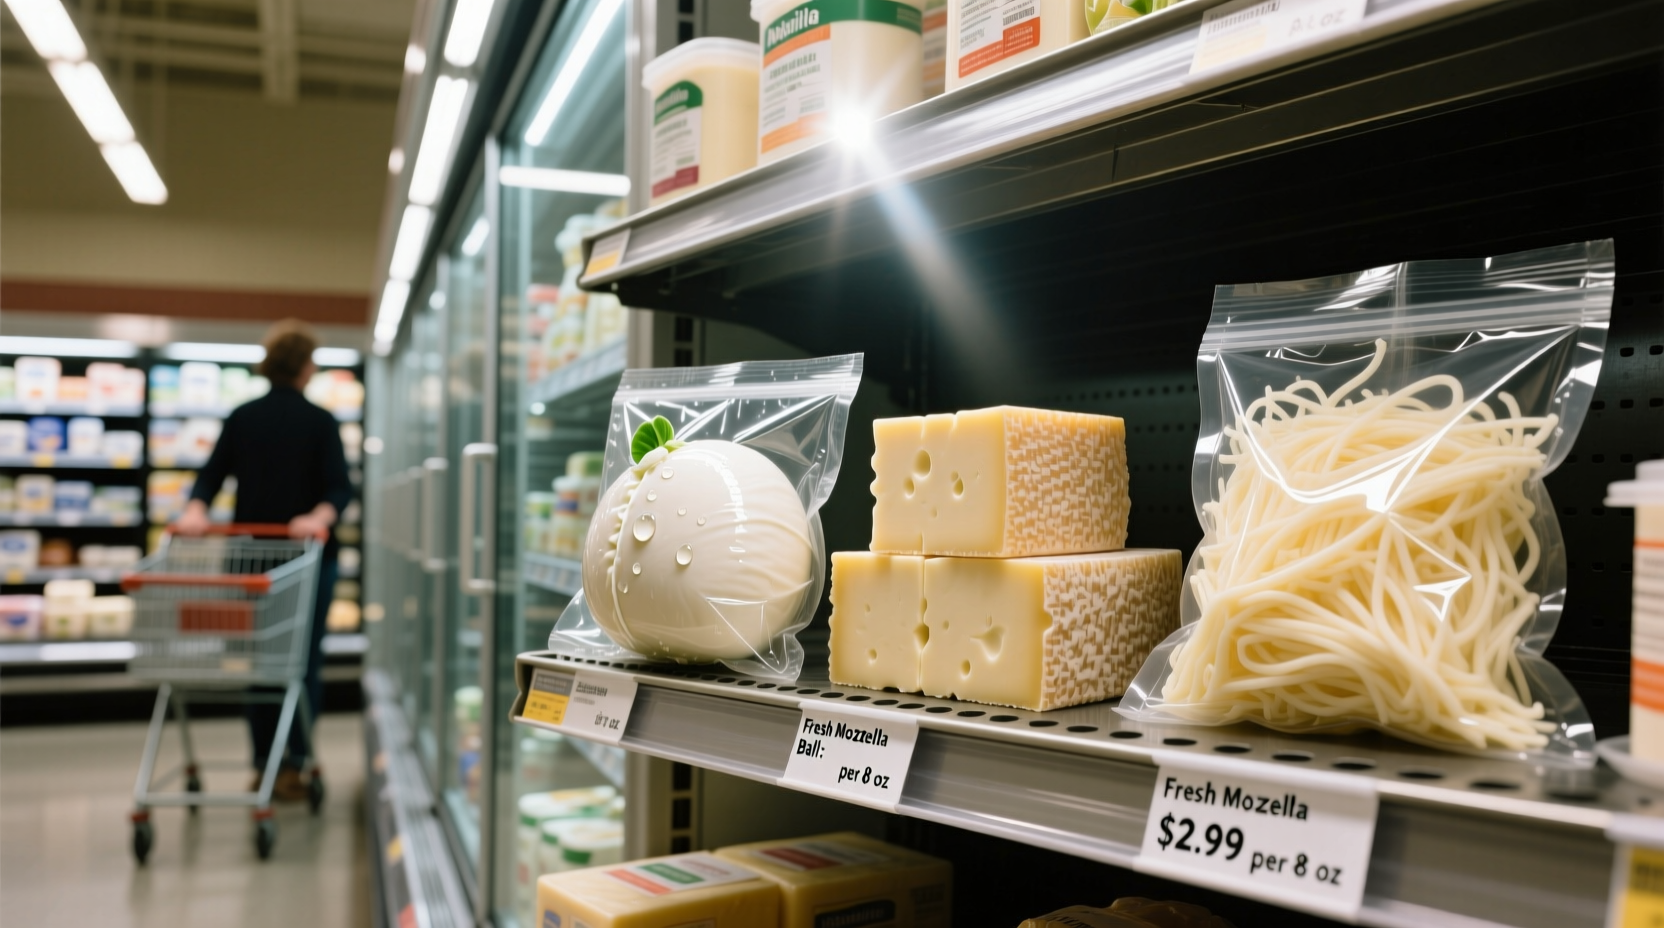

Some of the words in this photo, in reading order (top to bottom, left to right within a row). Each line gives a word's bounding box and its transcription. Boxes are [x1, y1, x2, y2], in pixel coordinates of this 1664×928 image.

[803, 717, 833, 737] Fresh
[796, 738, 825, 759] Ball:
[838, 766, 860, 784] per
[862, 766, 872, 785] 8
[873, 774, 890, 789] oz
[1162, 776, 1217, 806] Fresh
[1222, 785, 1309, 821] Mozella
[1157, 812, 1245, 862] $2.99
[1250, 850, 1288, 875] per
[1294, 852, 1309, 877] 8
[1316, 864, 1342, 886] oz
